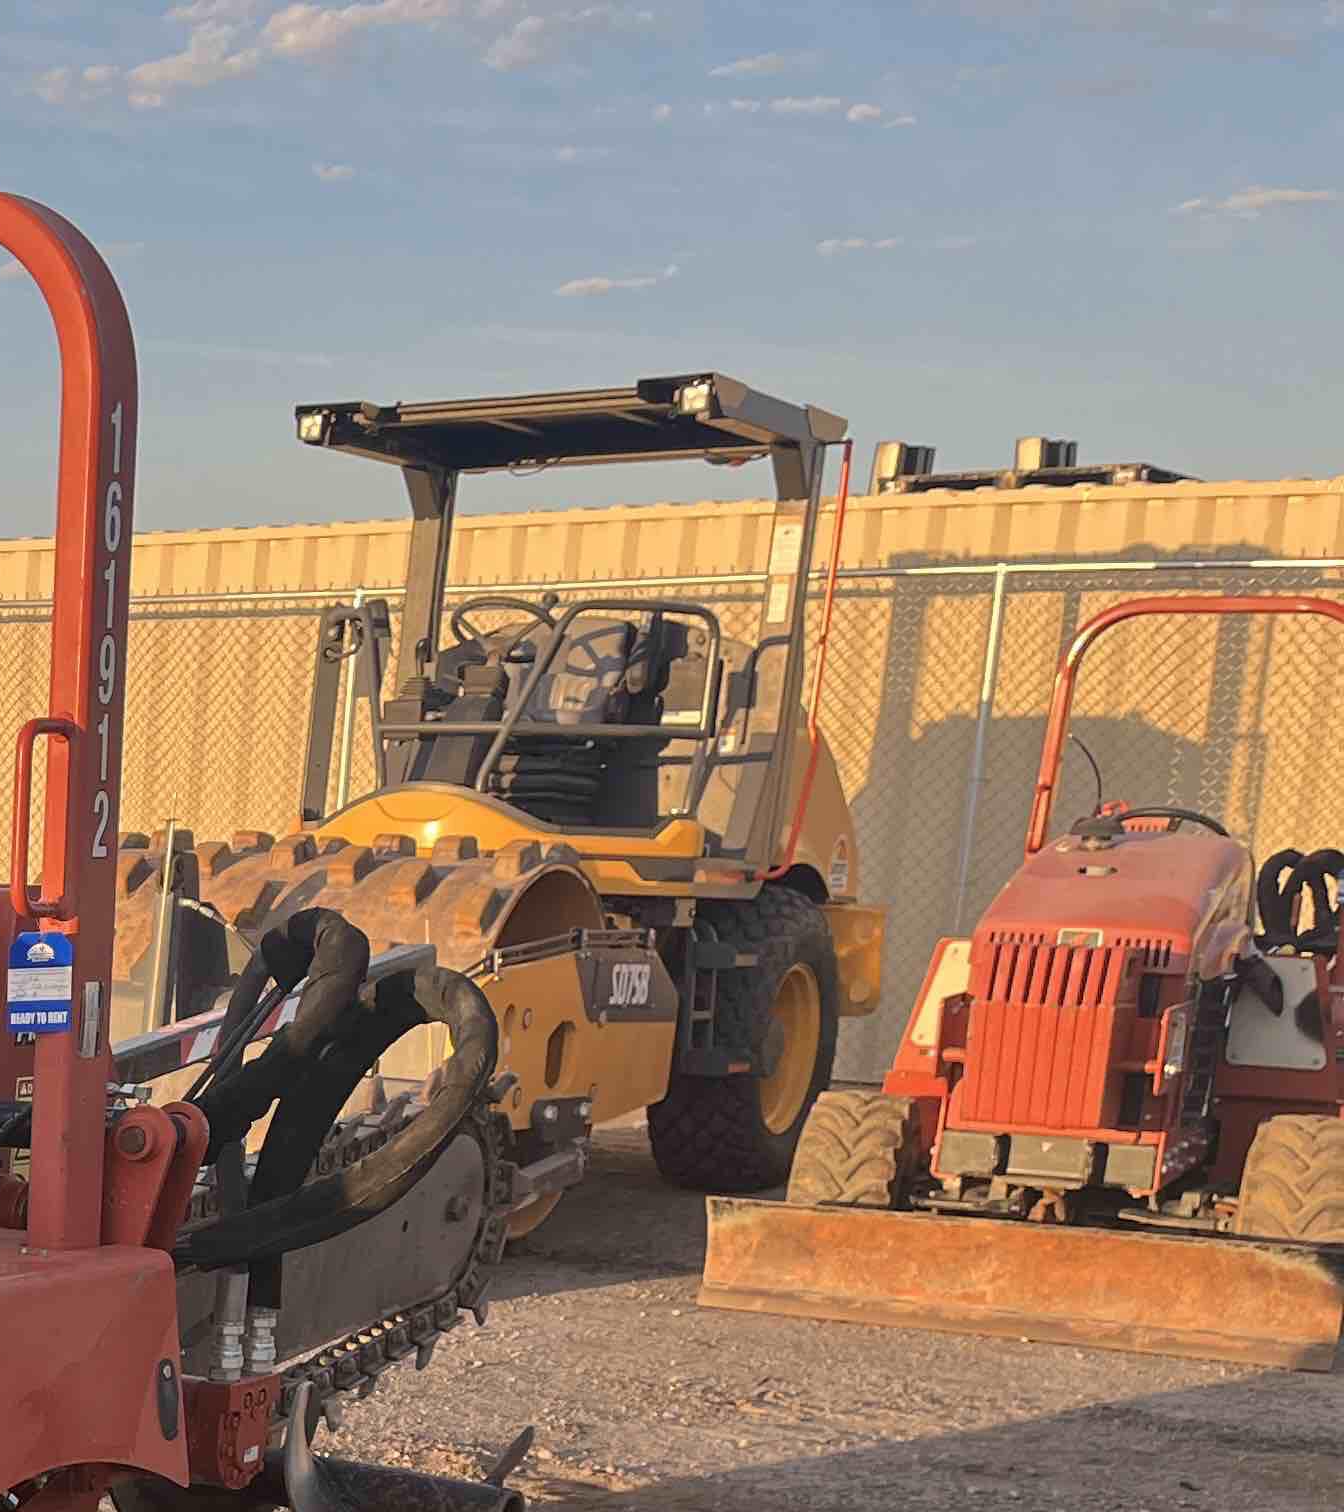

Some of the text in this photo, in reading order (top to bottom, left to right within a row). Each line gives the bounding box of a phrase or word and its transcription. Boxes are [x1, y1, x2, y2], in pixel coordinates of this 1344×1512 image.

[90, 402, 125, 858] 161912
[10, 1012, 35, 1025] READY
[37, 1012, 47, 1025] TO
